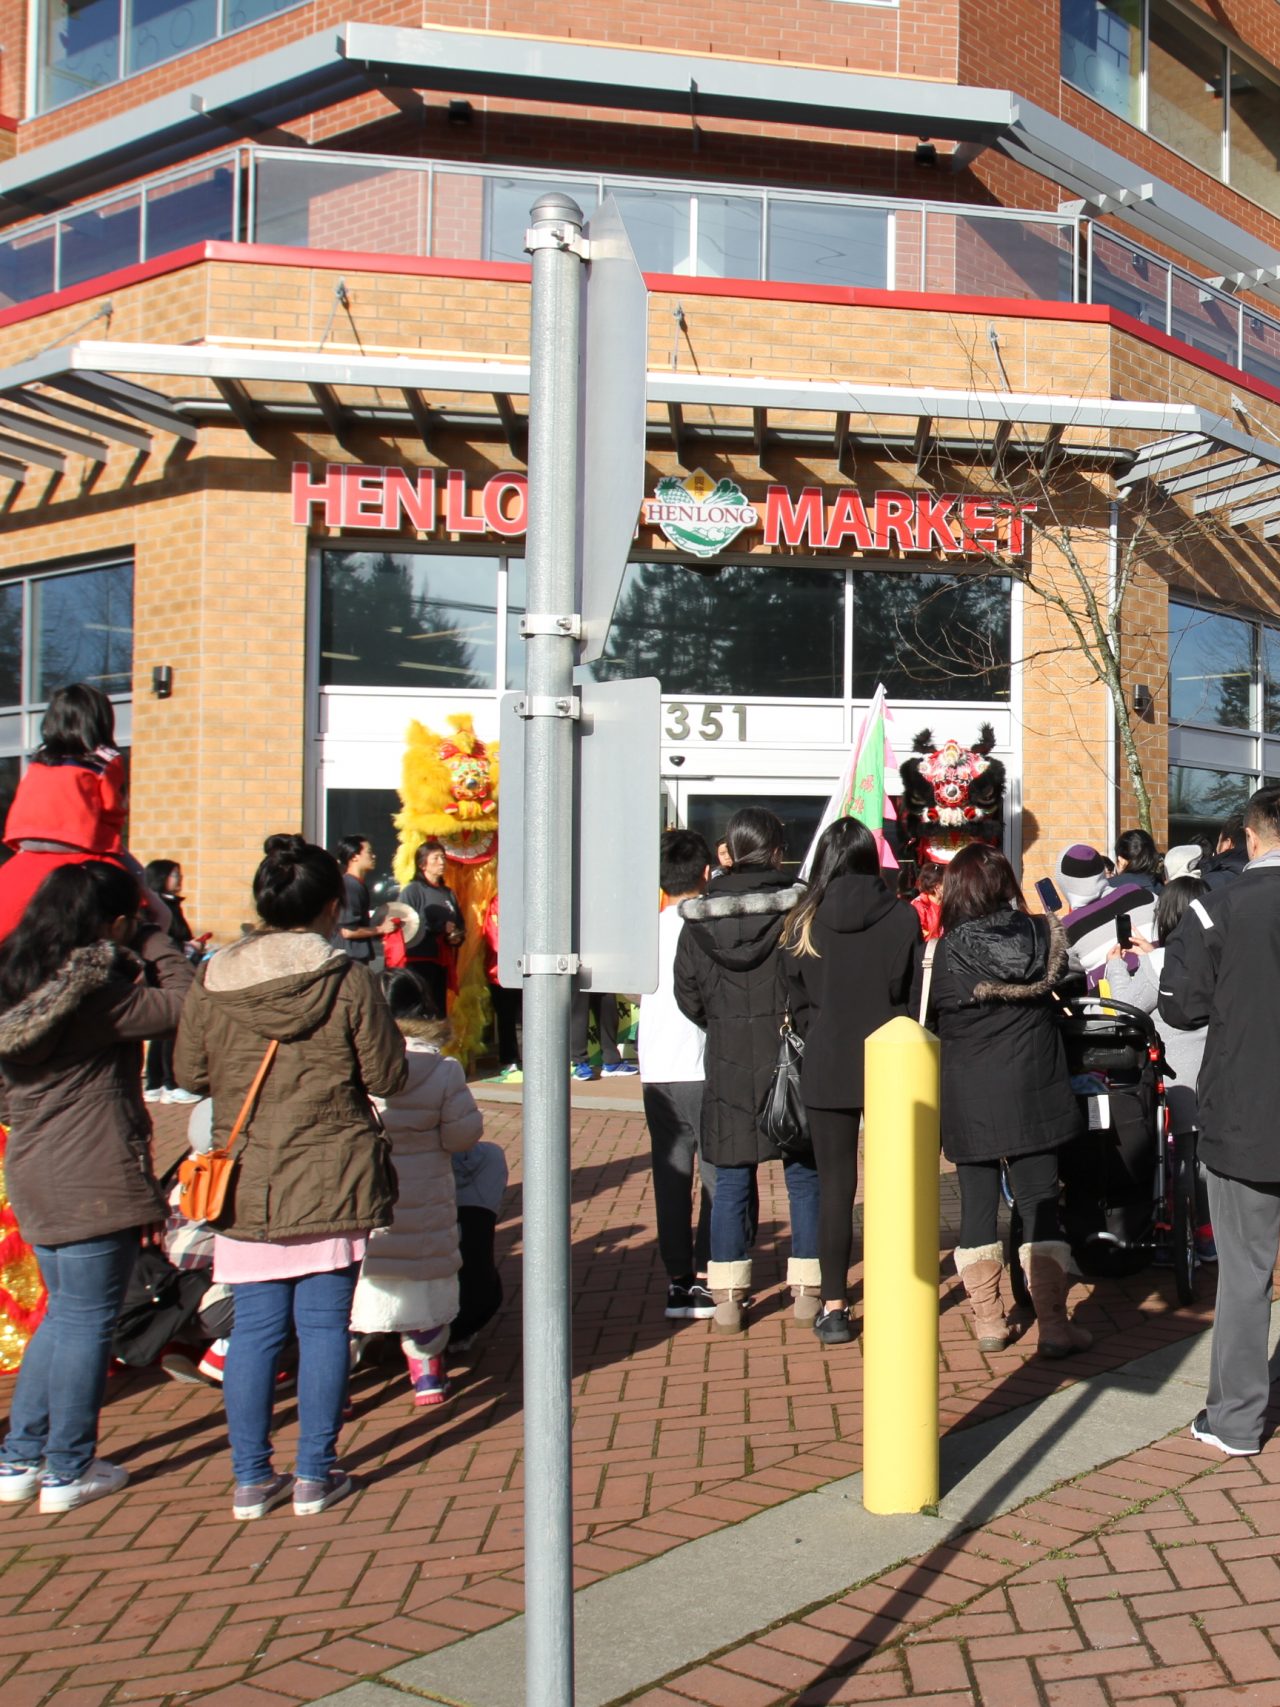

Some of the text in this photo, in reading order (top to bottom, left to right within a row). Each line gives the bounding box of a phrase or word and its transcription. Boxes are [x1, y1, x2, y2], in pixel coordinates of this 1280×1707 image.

[648, 503, 755, 525] HENLONG
[763, 484, 1038, 556] MARKET
[664, 703, 747, 742] 351
